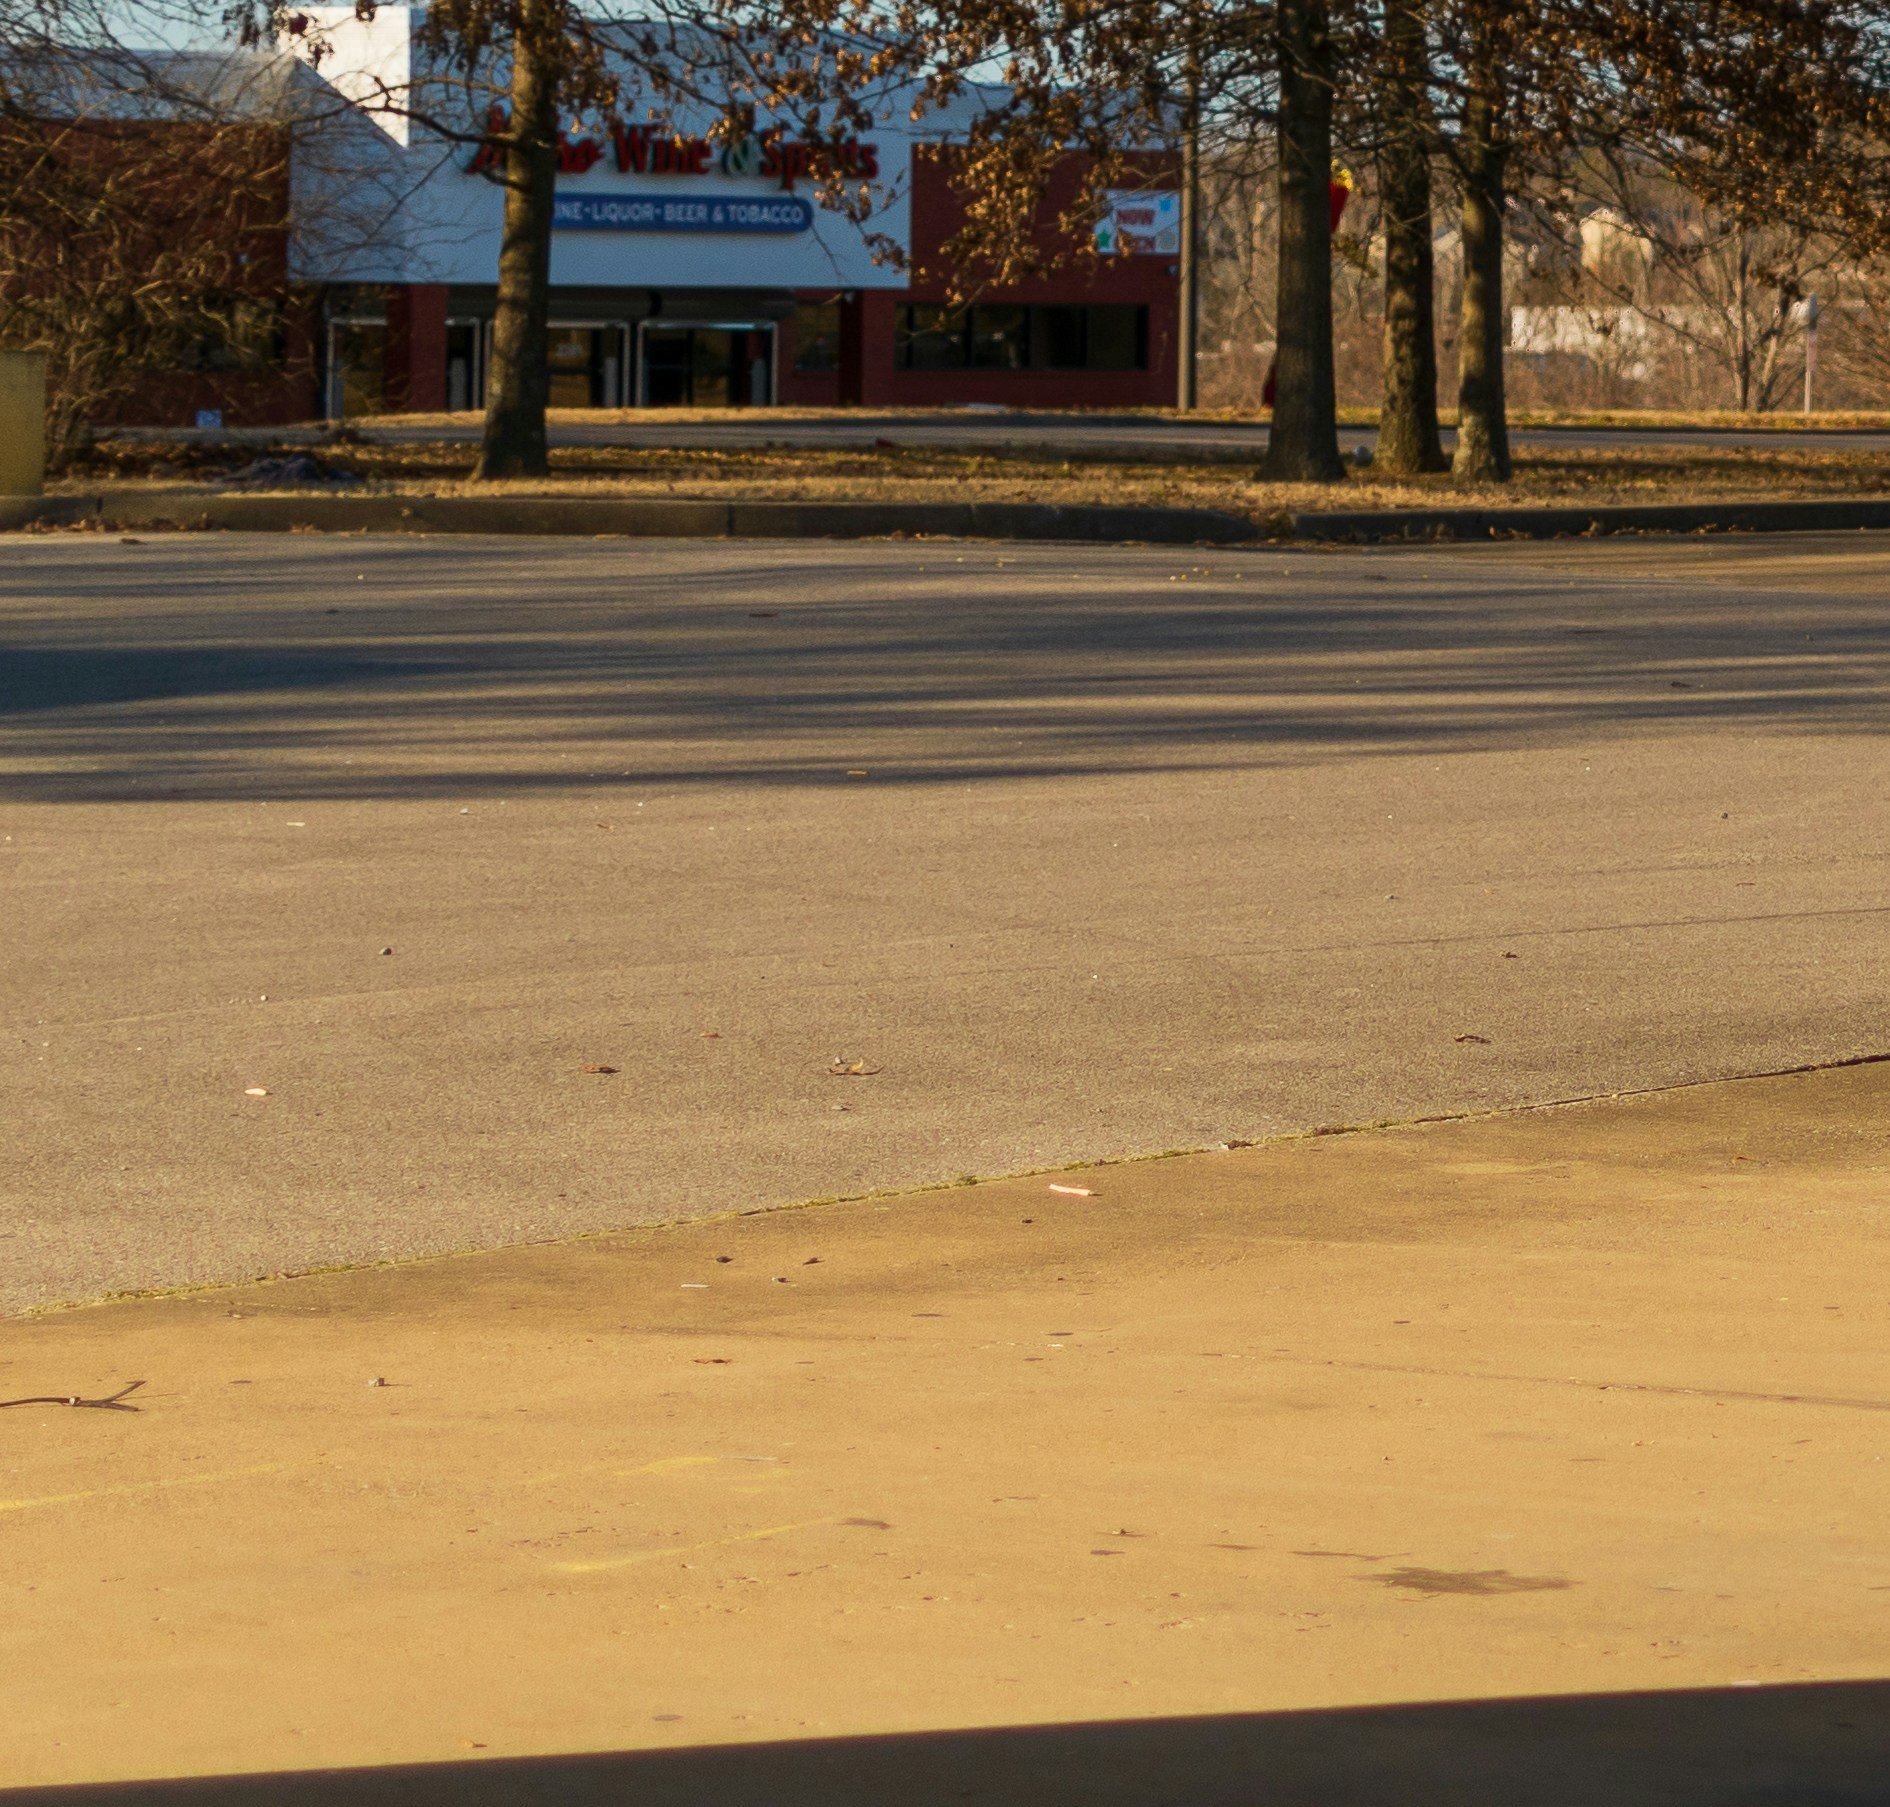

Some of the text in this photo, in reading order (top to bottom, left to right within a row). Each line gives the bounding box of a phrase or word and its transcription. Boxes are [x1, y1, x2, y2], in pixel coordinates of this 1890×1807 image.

[614, 123, 711, 175] Wine
[553, 201, 804, 224] INE LIQUOR BEER & TOBACCO
